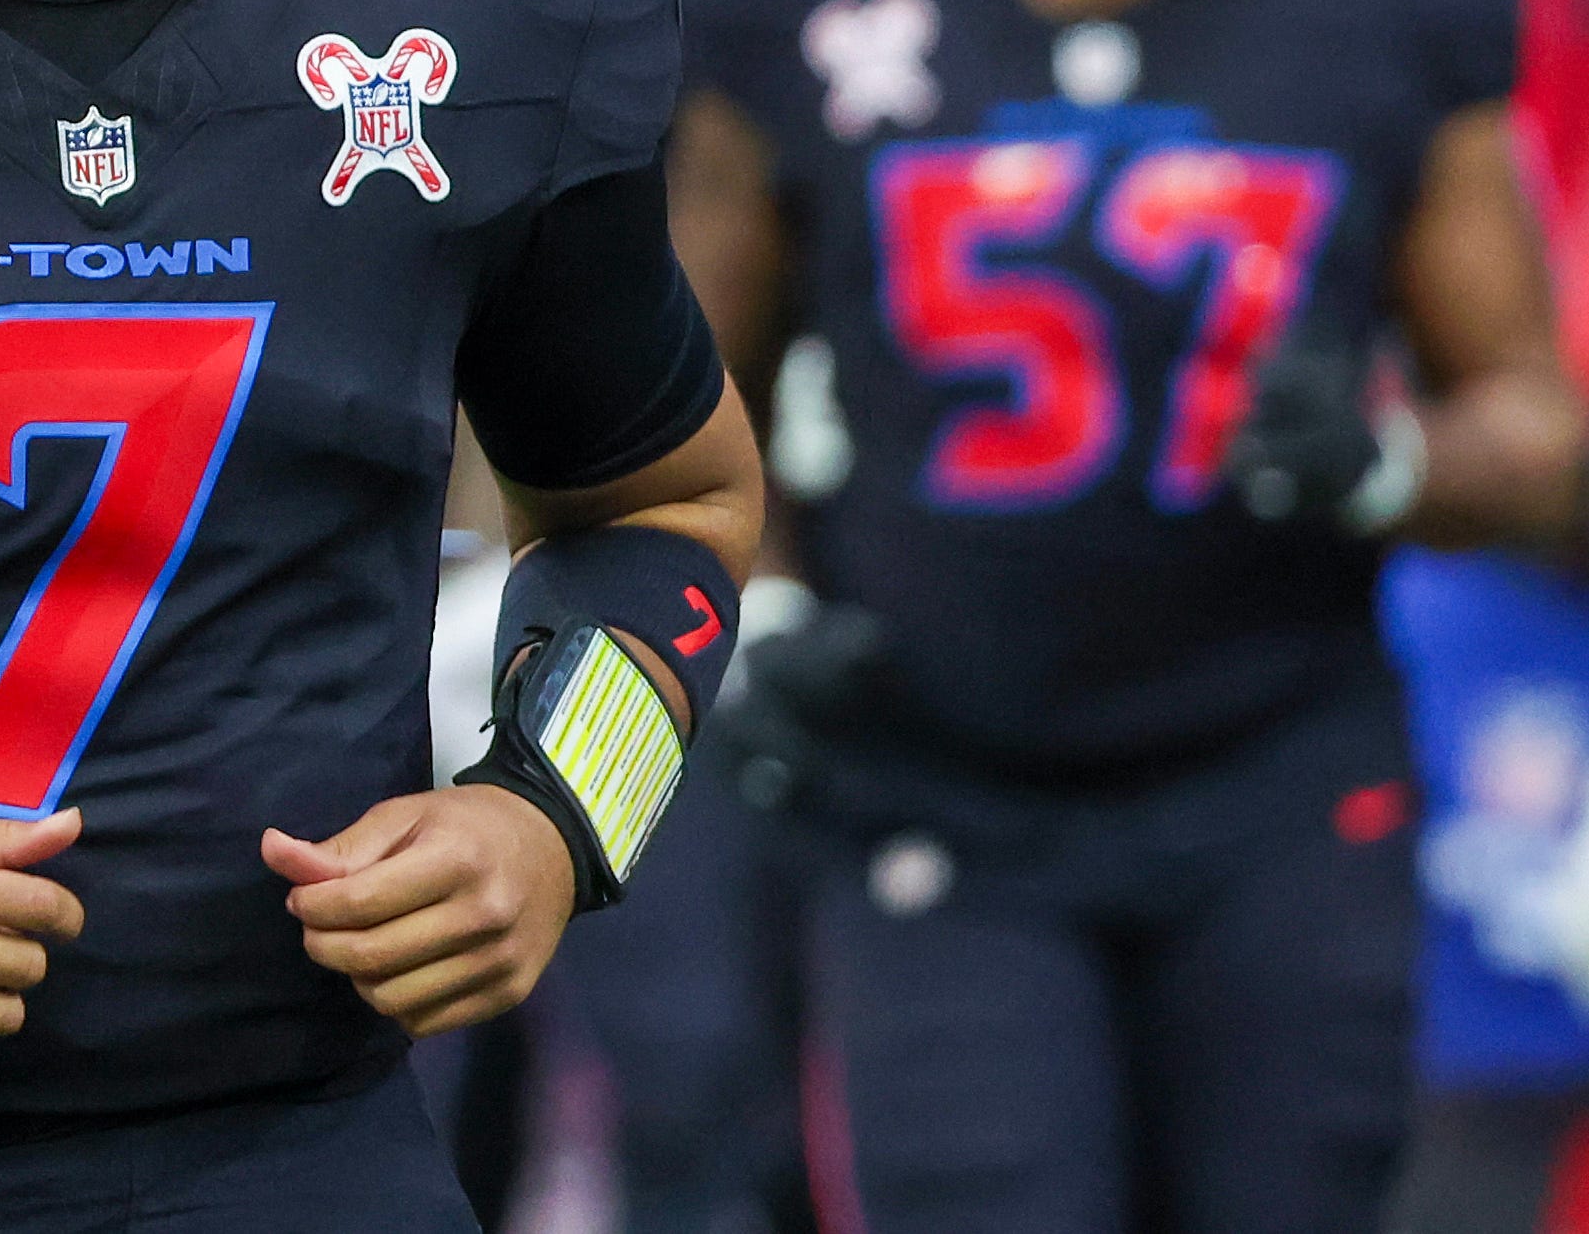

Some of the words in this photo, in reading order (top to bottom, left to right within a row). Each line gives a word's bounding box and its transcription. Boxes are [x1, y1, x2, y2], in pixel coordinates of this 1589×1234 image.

[357, 109, 408, 147] NFL
[73, 152, 123, 187] NFL
[874, 142, 1338, 508] 57
